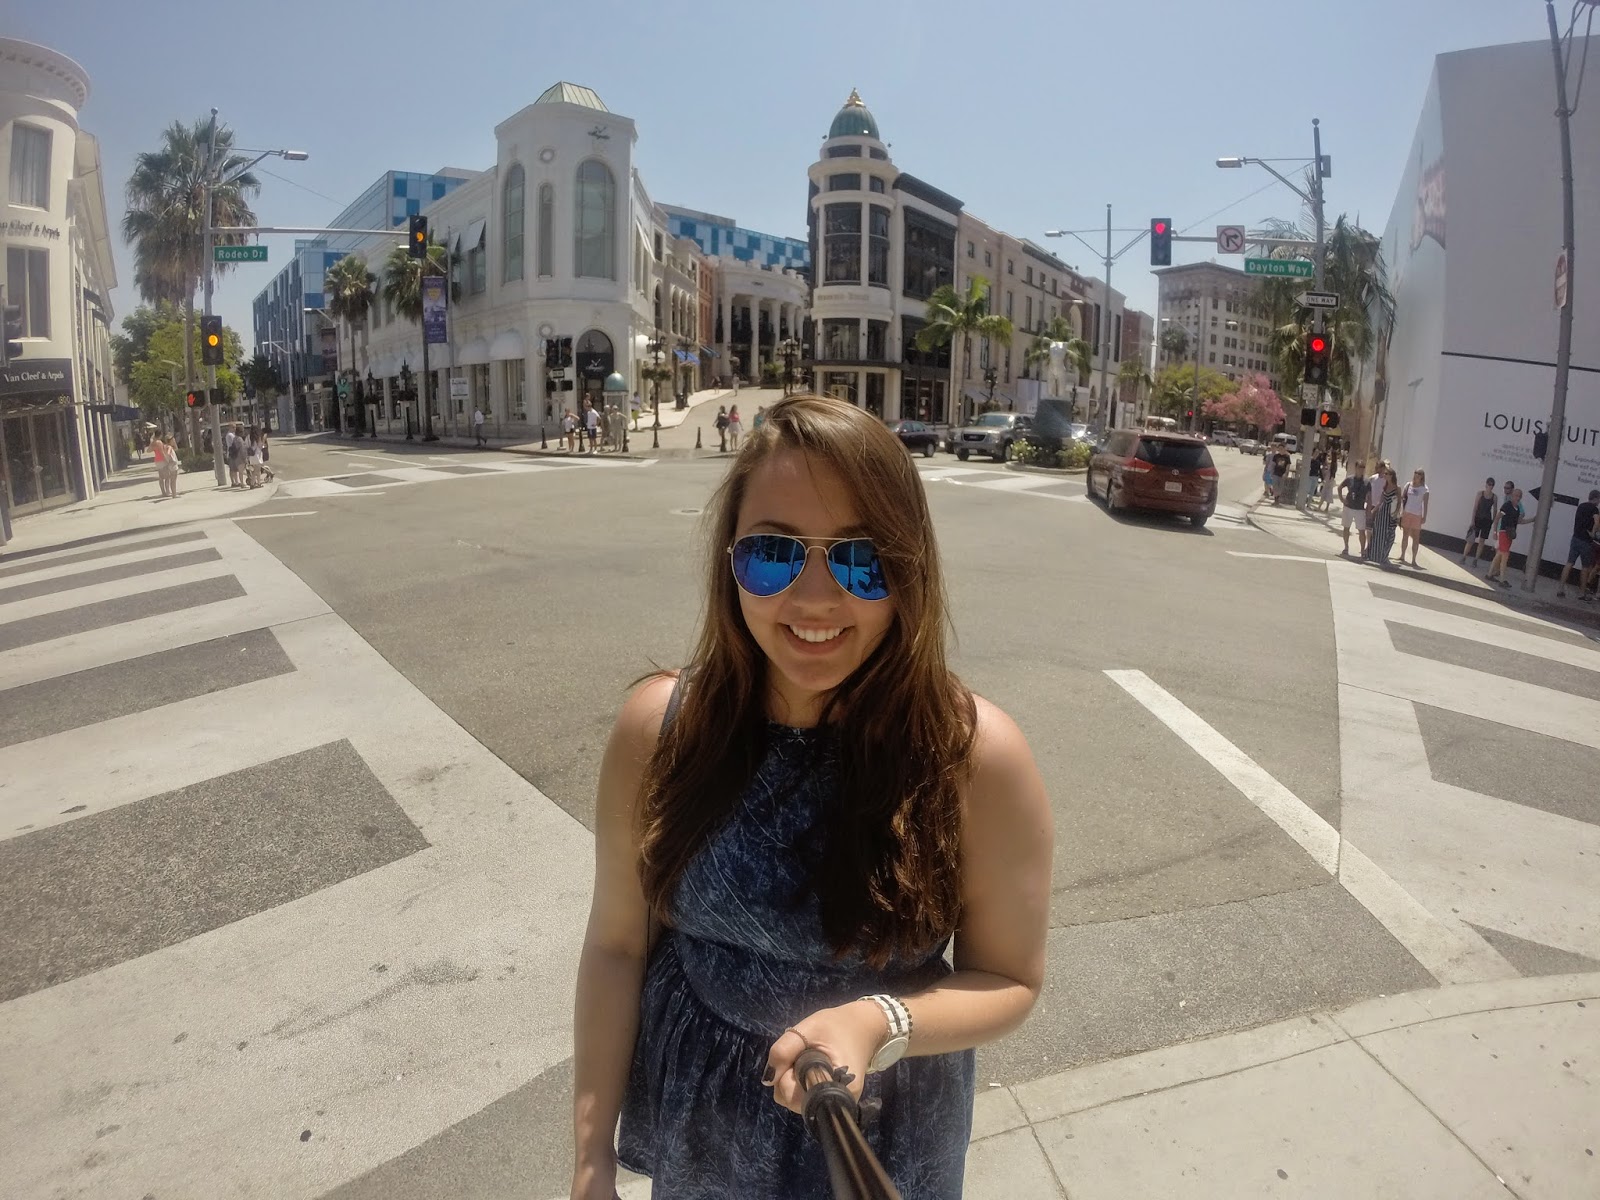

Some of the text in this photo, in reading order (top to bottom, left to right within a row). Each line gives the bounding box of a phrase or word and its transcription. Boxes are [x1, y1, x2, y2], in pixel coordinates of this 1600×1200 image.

[218, 249, 264, 259] Rodeo Dr
[1249, 261, 1309, 275] Dayton Way
[4, 374, 20, 382] Van
[21, 371, 41, 381] Cleef
[48, 370, 65, 382] Arpels
[1484, 412, 1543, 436] LOUIS
